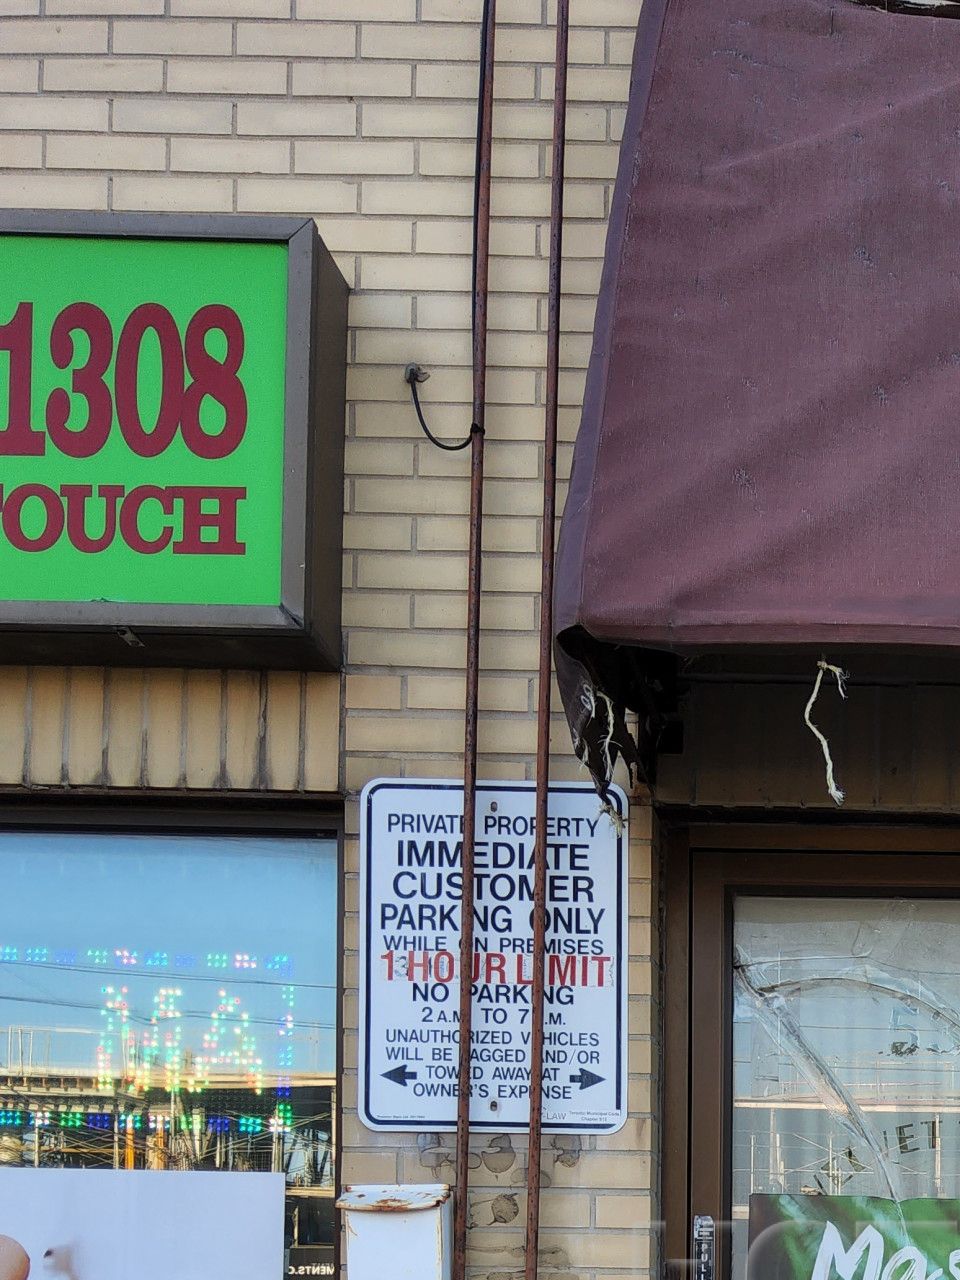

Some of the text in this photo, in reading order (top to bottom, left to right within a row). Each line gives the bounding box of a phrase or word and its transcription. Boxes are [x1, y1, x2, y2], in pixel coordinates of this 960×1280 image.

[0, 300, 248, 459] 1308
[0, 483, 247, 555] OUCH
[397, 839, 590, 871] IMMEDIATE
[392, 870, 595, 902] CUSTOMER
[380, 903, 606, 935] PARKNG ONLY
[383, 935, 604, 955] WHILE N PREMISES
[380, 950, 394, 981] 1
[516, 954, 611, 987] LMIT
[412, 982, 574, 1006] NO PARKNG
[421, 1006, 433, 1023] 2
[437, 1010, 462, 1023] A.M
[480, 1008, 508, 1025] TO
[518, 1008, 530, 1024] 7
[521, 1031, 600, 1046] VHICLES
[385, 1046, 600, 1065] WILL BE AGGED ND/OR
[426, 1065, 561, 1082] TOWD AWAY AT
[498, 1085, 572, 1100] EXPNSE
